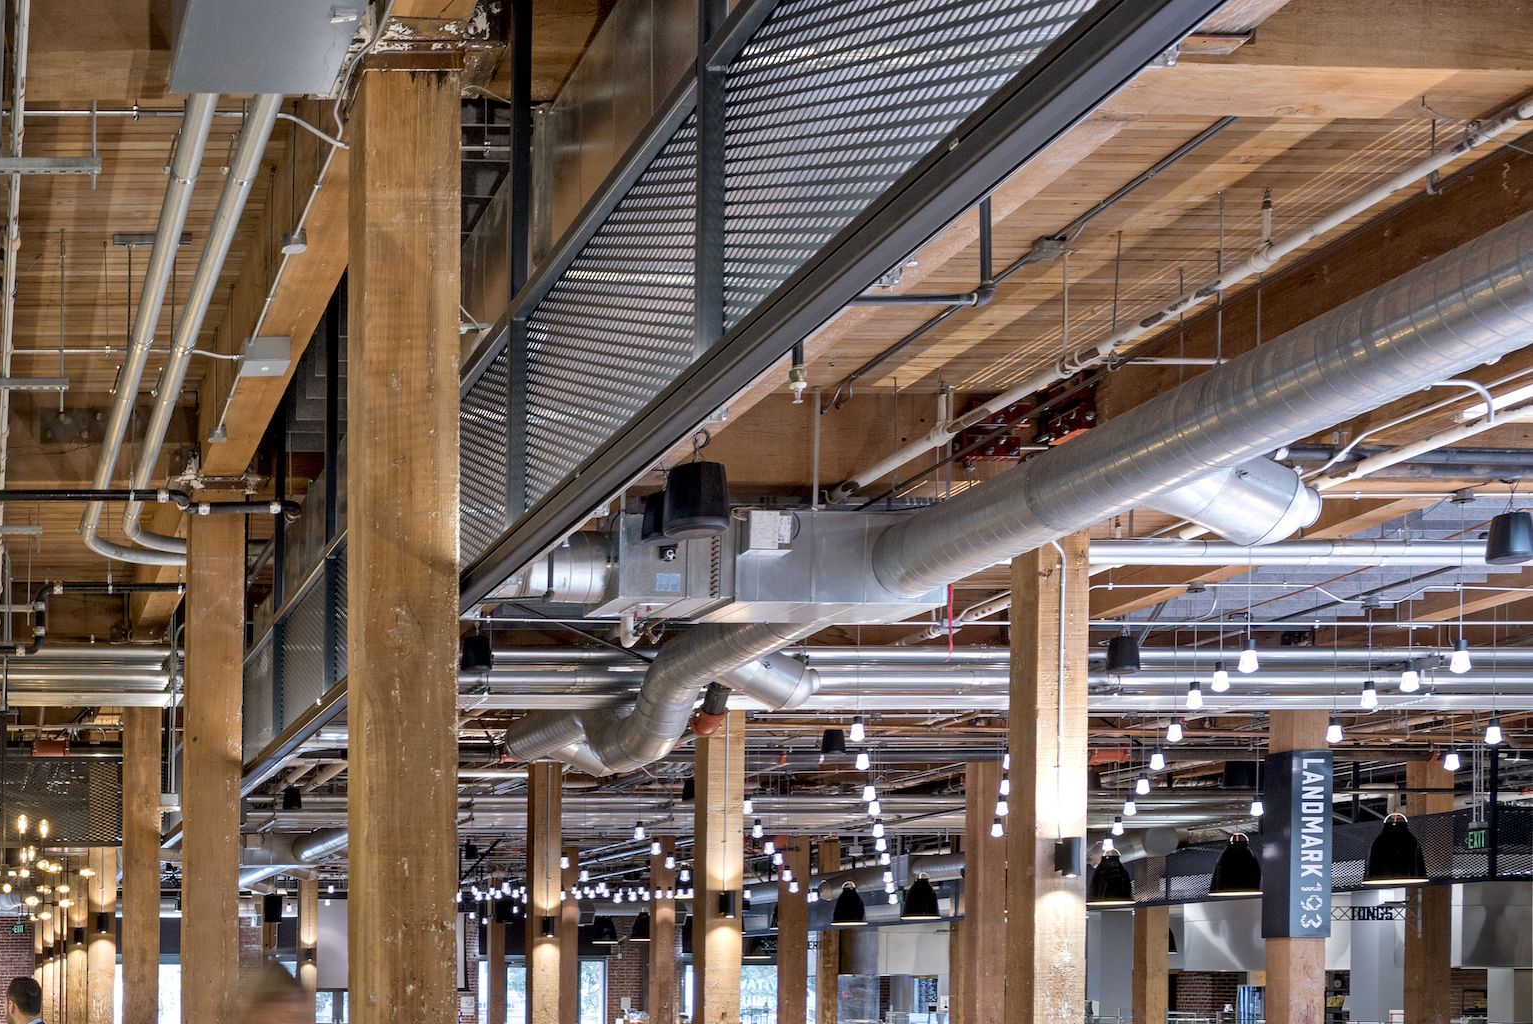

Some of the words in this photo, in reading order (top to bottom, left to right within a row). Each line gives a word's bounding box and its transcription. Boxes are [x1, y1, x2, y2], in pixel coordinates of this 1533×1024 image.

[1300, 758, 1325, 878] LANDMARK
[1468, 830, 1486, 850] EXIT
[1300, 882, 1323, 929] 193
[1350, 906, 1394, 920] TONGS
